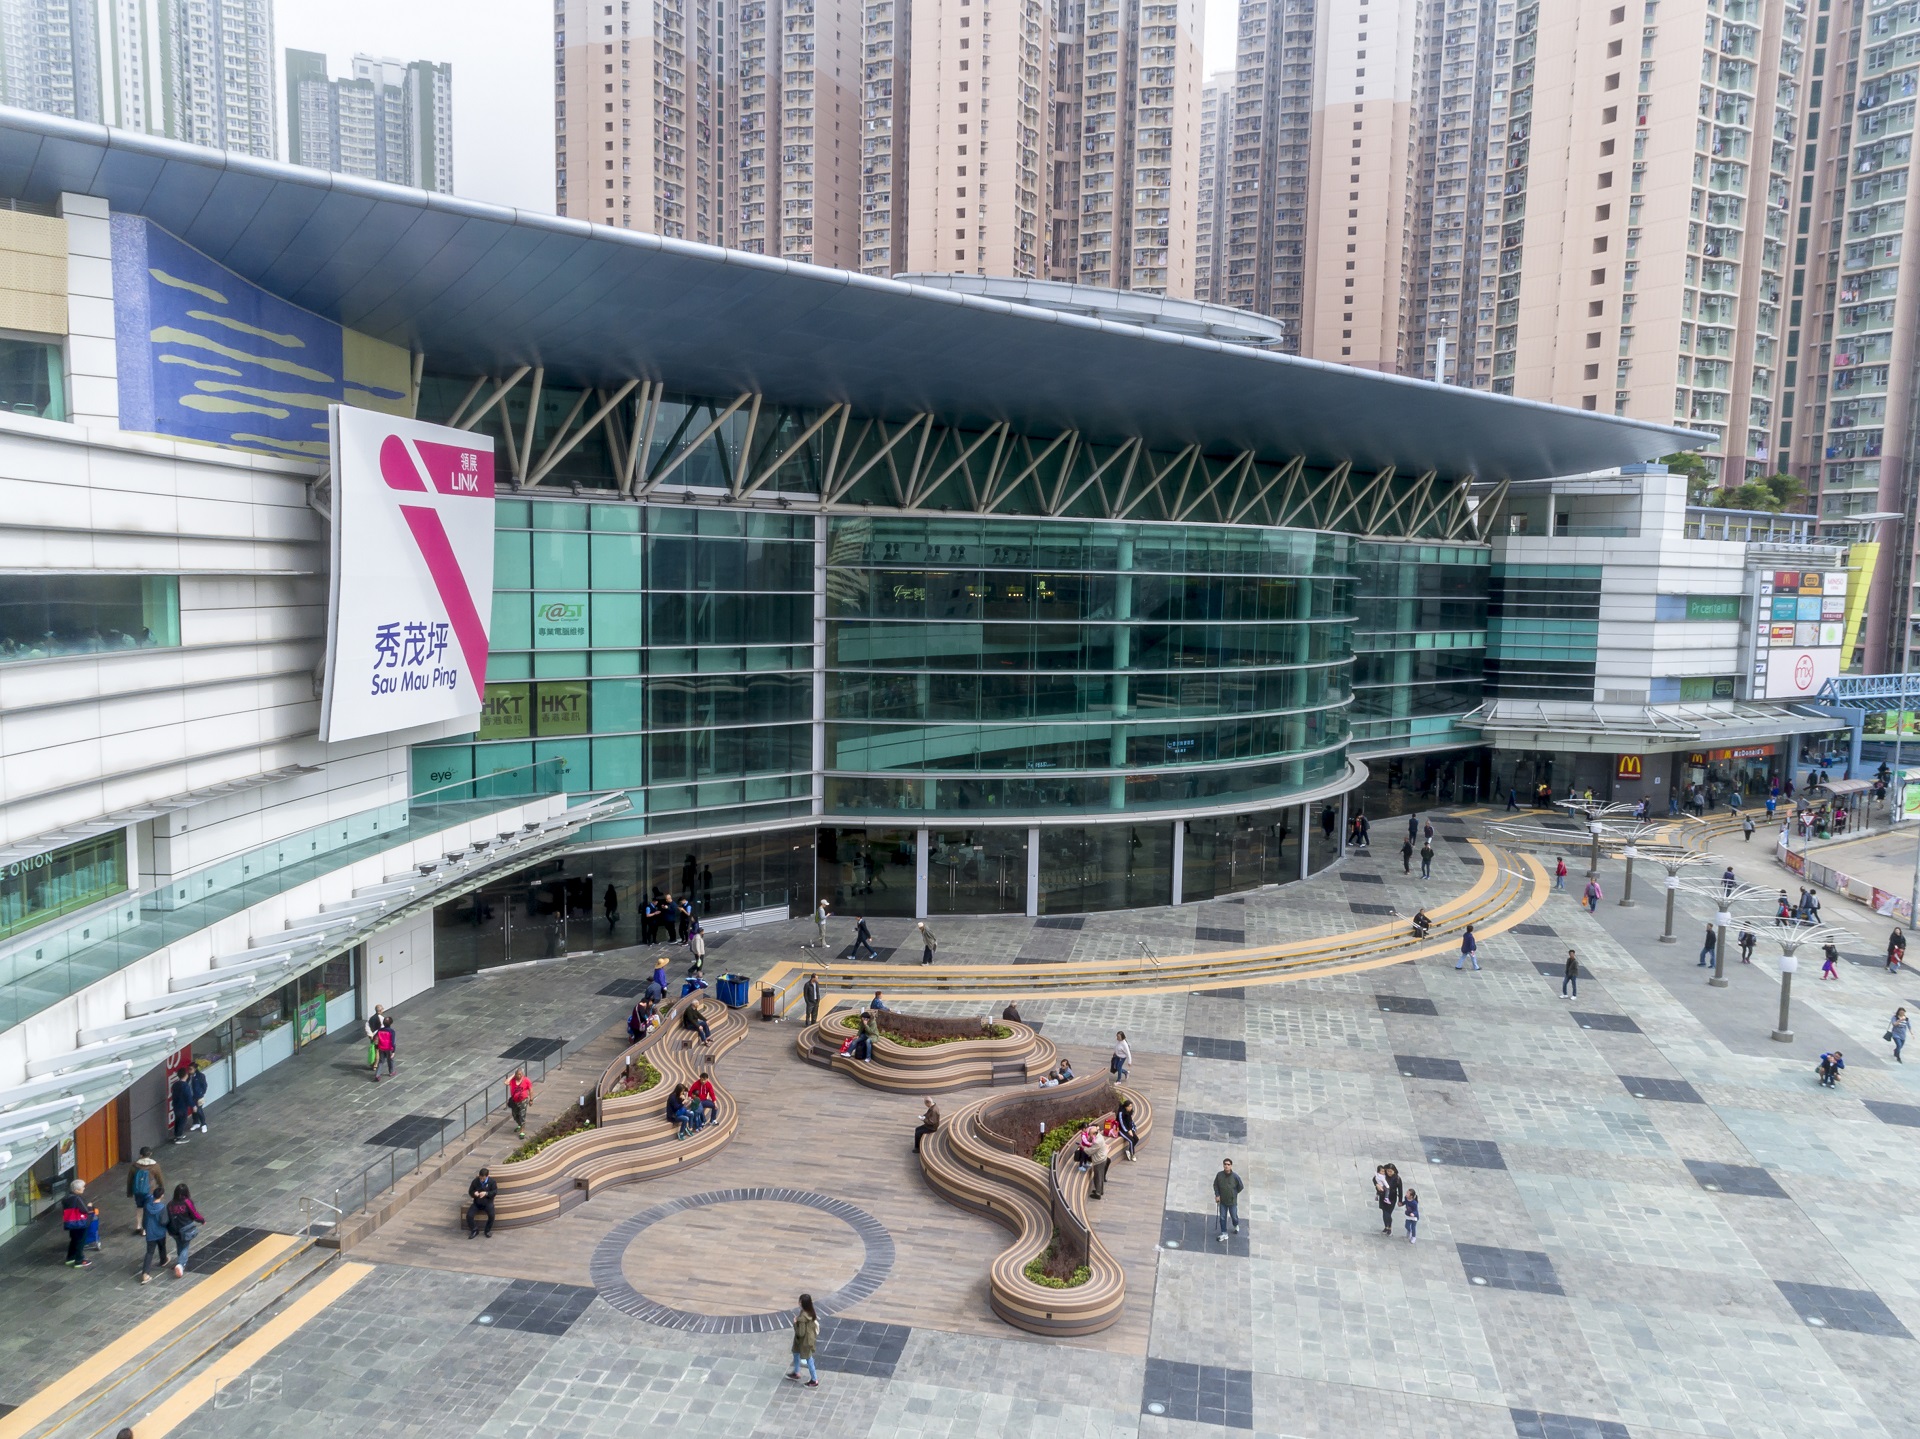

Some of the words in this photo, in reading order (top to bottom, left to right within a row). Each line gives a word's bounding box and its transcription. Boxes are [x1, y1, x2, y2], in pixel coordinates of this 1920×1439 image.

[460, 452, 478, 472] 領展
[451, 471, 478, 492] LINK
[373, 621, 449, 670] 秀茂坪
[371, 673, 397, 696] Sau
[400, 671, 430, 692] Mau
[433, 667, 457, 690] Ping
[482, 696, 525, 715] HKT
[541, 694, 582, 713] HKT
[430, 769, 452, 783] eye
[10, 852, 53, 877] ONION
